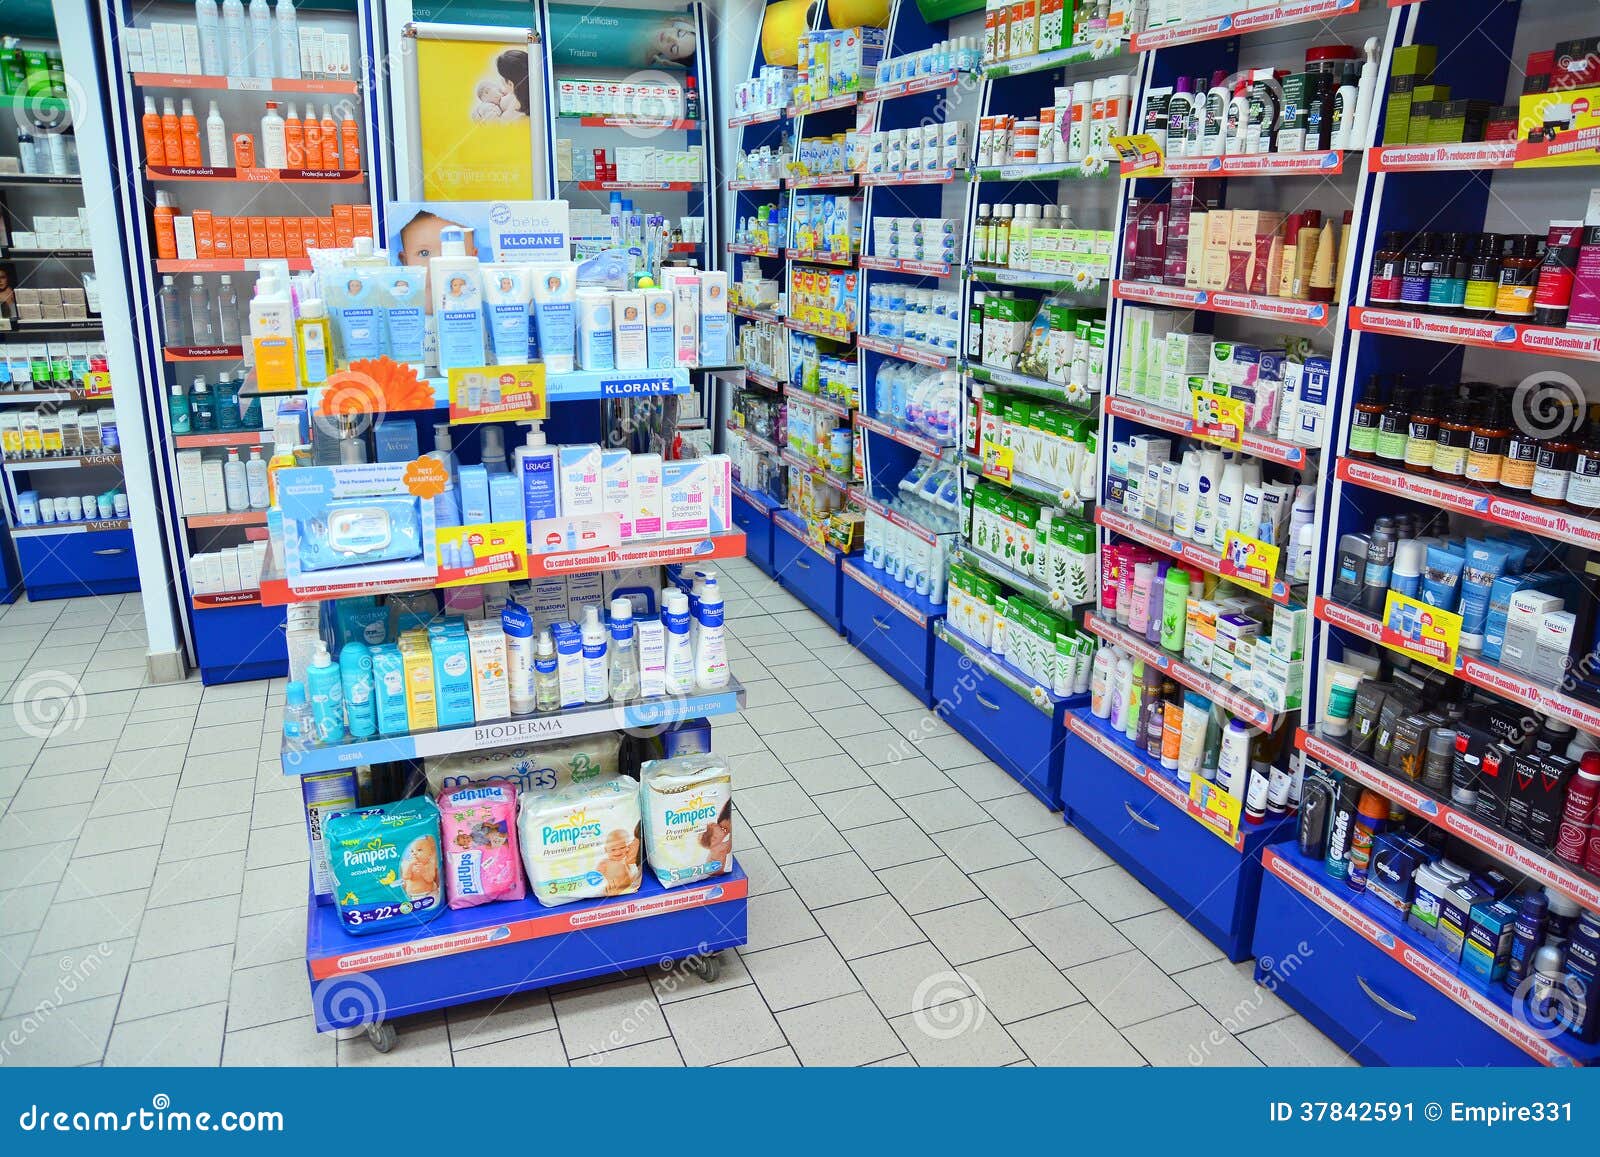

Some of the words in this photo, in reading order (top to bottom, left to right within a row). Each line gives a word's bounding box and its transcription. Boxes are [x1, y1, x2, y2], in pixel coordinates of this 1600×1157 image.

[581, 16, 619, 26] Purificare
[568, 48, 597, 58] Tratare
[504, 236, 561, 246] KLORANE
[446, 312, 476, 320] KLORANE
[1385, 317, 1406, 328] Sensiblu
[1425, 322, 1448, 333] reducere
[1524, 334, 1533, 343] Cu
[1534, 334, 1554, 345] cardul
[1554, 335, 1583, 349] Sensiblu
[1584, 340, 1590, 350] ai
[605, 382, 671, 394] KLORANE
[86, 456, 117, 464] VICHY
[526, 462, 551, 471] URIAGE
[91, 520, 122, 529] VICHY
[1492, 504, 1500, 514] Cu
[1501, 507, 1520, 520] cardul
[1521, 512, 1548, 527] Sensiblu
[1548, 518, 1554, 528] ai
[1556, 518, 1570, 533] 10%
[1369, 542, 1386, 552] Dove
[574, 556, 600, 566] Sensiblu
[622, 552, 648, 561] reducere
[570, 594, 601, 602] STELATOPIA
[534, 604, 566, 612] STELATOPIA
[1514, 600, 1536, 612] Eucerin
[1544, 620, 1568, 632] Eucerin
[1468, 666, 1476, 676] Cu
[1476, 669, 1494, 682] cardul
[1495, 676, 1520, 694] Sensiblu
[1520, 686, 1526, 696] ai
[1572, 709, 1583, 720] din
[474, 719, 562, 741] BIODERMA
[1490, 716, 1518, 734] VICHY
[1516, 762, 1536, 775] VICHY
[1540, 762, 1562, 776] VICHY
[665, 805, 716, 826] Pampers
[1330, 810, 1350, 860] Gillette
[1448, 816, 1455, 824] Cu
[1455, 819, 1472, 834] cardul
[1473, 828, 1497, 848] Sensiblu
[1519, 855, 1546, 875] reducere
[1547, 871, 1558, 881] din
[343, 846, 399, 867] Pampers
[670, 868, 680, 882] 5
[1377, 862, 1400, 882] Gillette
[549, 882, 558, 894] 3
[567, 882, 577, 892] 27
[348, 910, 362, 924] 3
[374, 906, 392, 920] 22
[1446, 907, 1461, 920] NIVEA
[1474, 926, 1490, 941] NIVEA
[1516, 921, 1533, 934] NIVEA
[1572, 942, 1595, 960] NIVEA
[1430, 968, 1452, 990] Sensiblu
[1472, 999, 1498, 1021] reducere
[1499, 1017, 1509, 1029] din
